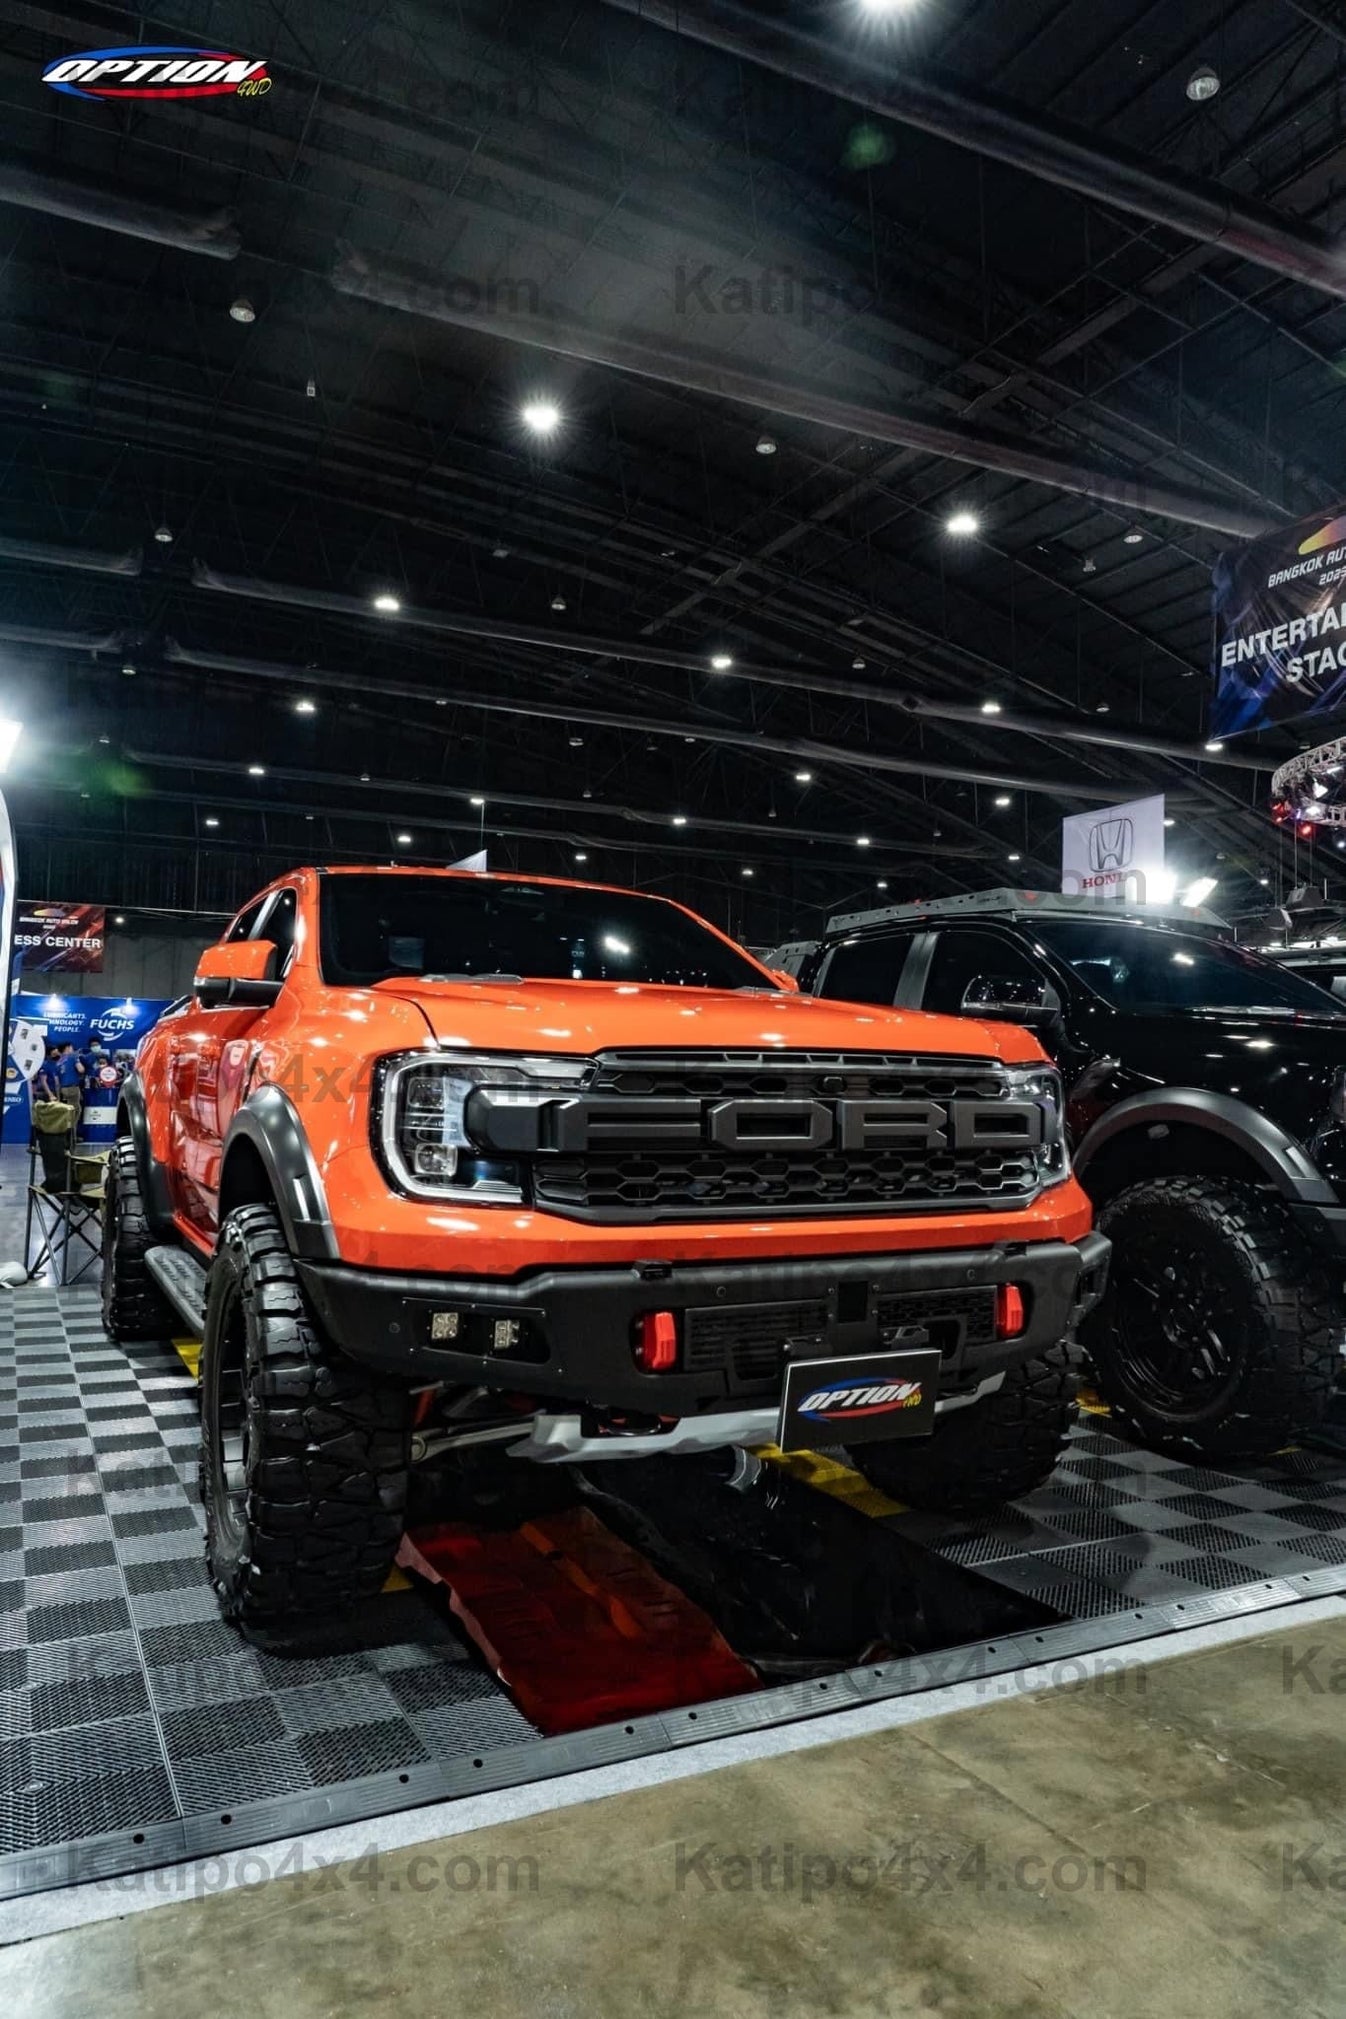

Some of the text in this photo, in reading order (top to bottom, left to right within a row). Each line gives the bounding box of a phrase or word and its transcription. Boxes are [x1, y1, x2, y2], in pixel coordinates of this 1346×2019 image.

[1267, 554, 1325, 589] BANGKOK
[45, 936, 101, 949] CENTER
[89, 1018, 135, 1030] FUCHS
[557, 1095, 1045, 1152] FORD
[797, 1381, 922, 1413] OPTION
